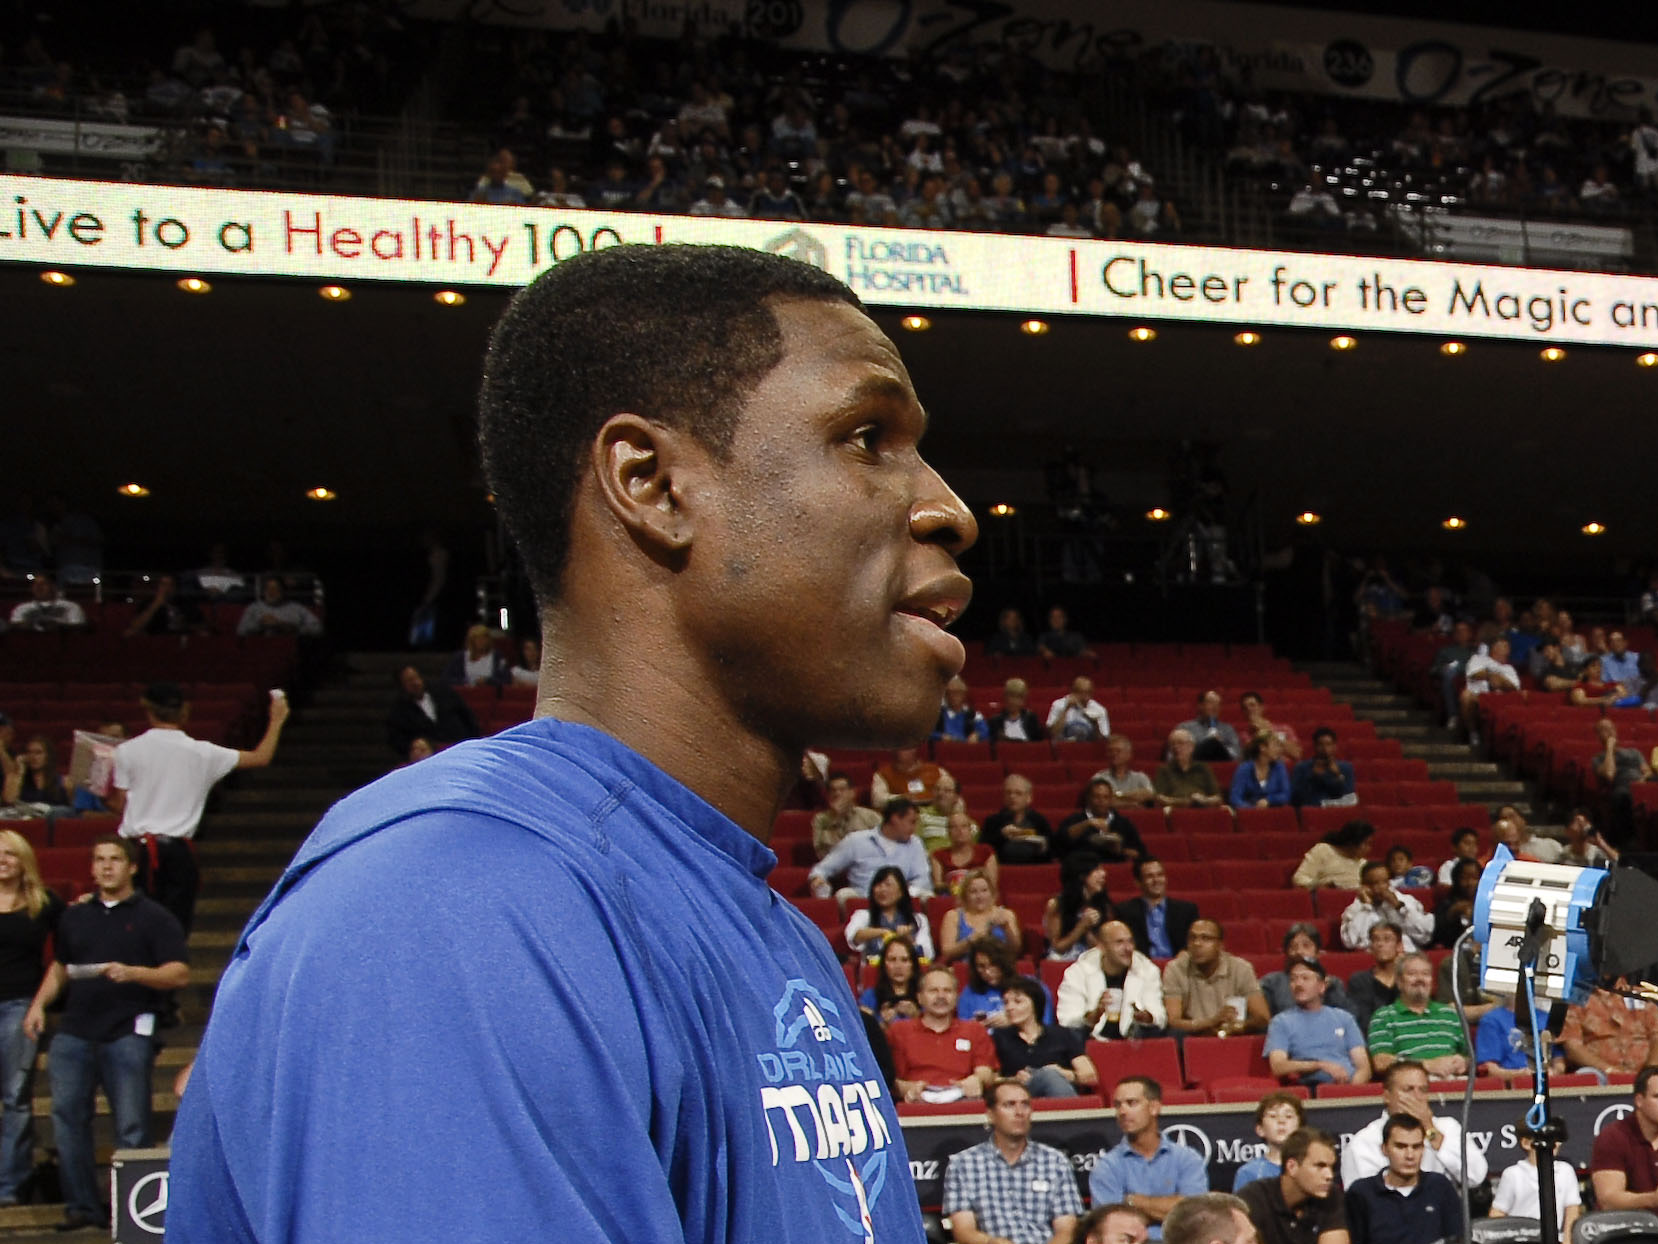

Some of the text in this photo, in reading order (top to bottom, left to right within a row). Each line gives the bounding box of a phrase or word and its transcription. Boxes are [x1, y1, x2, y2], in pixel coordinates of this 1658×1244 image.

[132, 208, 190, 250] to
[219, 222, 254, 253] a
[284, 209, 509, 277] Healthy
[845, 234, 950, 265] FLORIDA
[846, 263, 968, 295] HOSPITAL
[1102, 256, 1249, 303] Cheer
[1271, 266, 1337, 308] for
[1358, 271, 1428, 315] the
[1448, 278, 1593, 332] Magic
